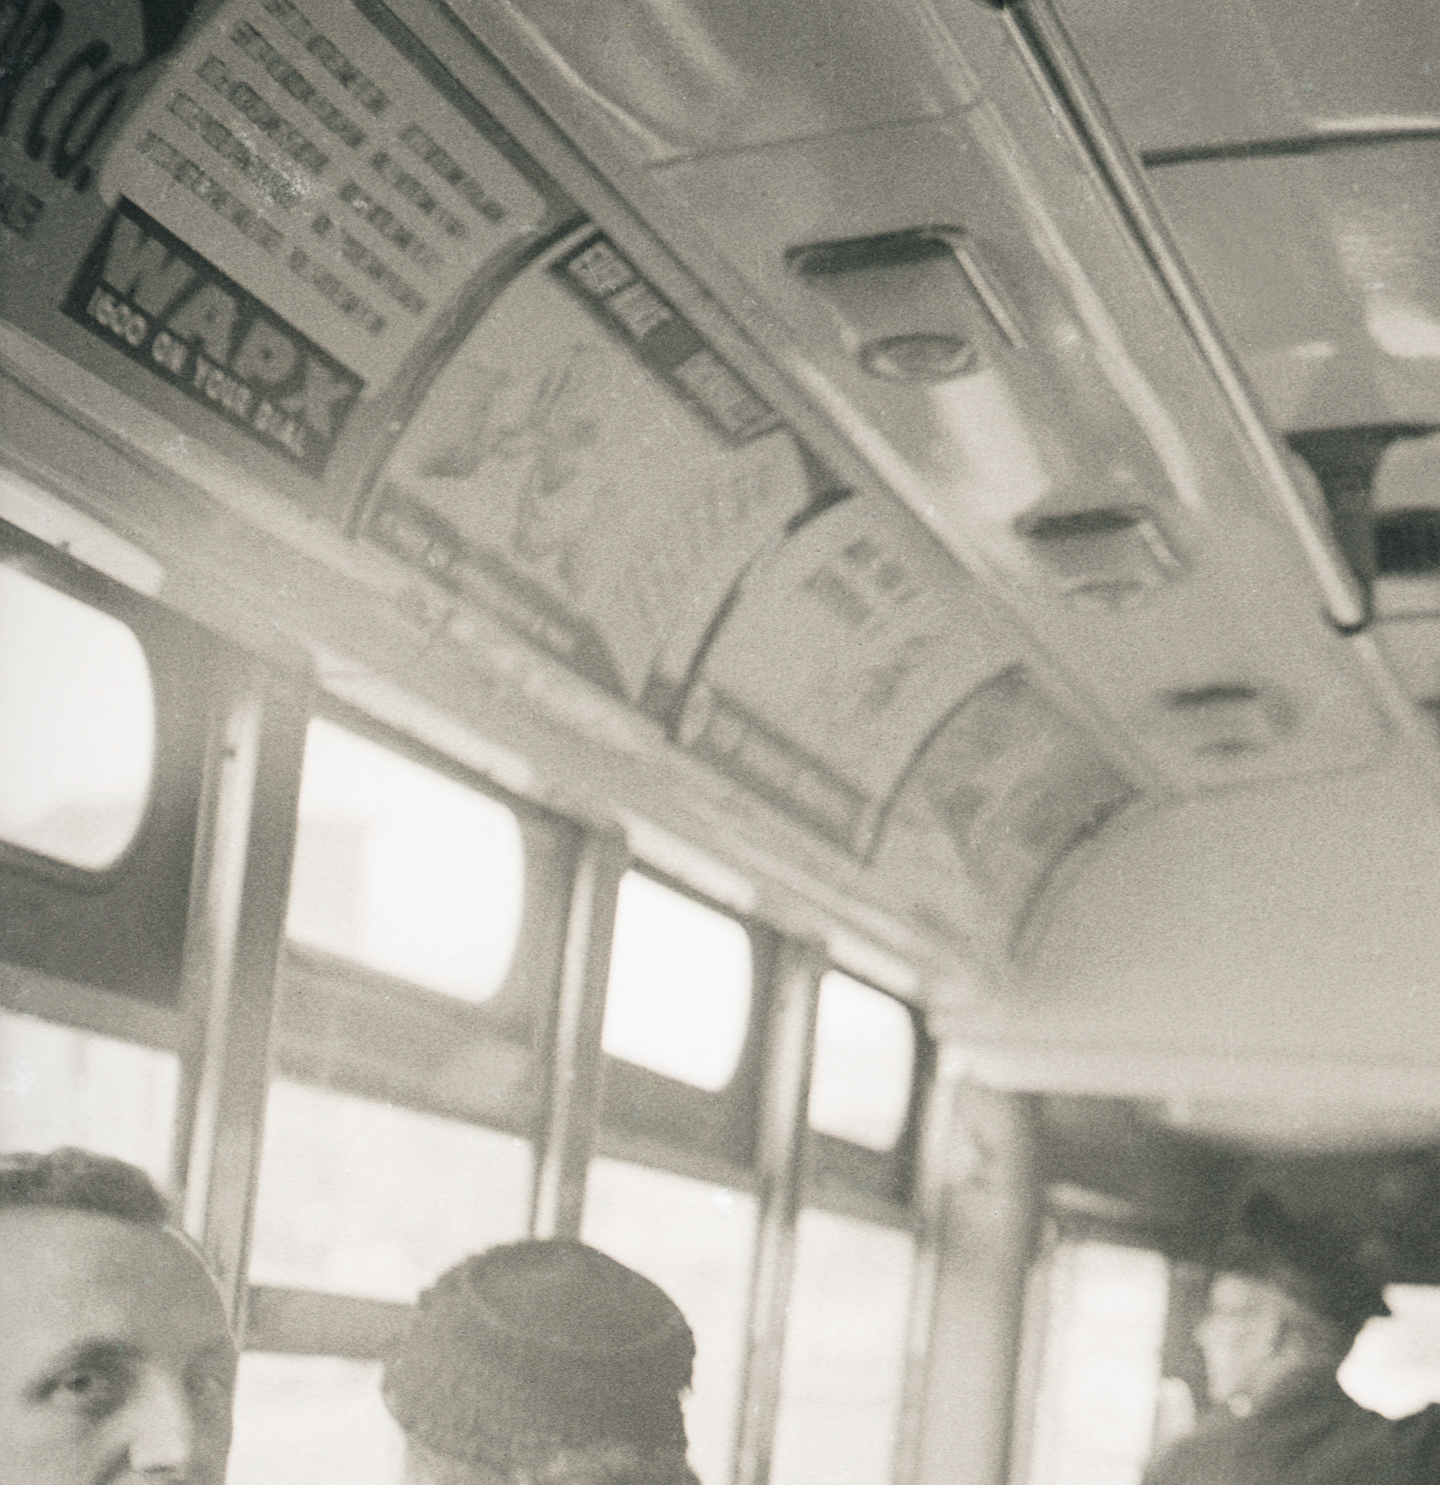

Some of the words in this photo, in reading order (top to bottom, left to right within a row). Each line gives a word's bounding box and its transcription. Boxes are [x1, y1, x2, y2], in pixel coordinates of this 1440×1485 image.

[86, 286, 149, 347] 1600
[151, 331, 187, 374] ON
[194, 353, 251, 417] YOUR
[254, 402, 305, 457] DIAL
[101, 211, 352, 436] WAPX
